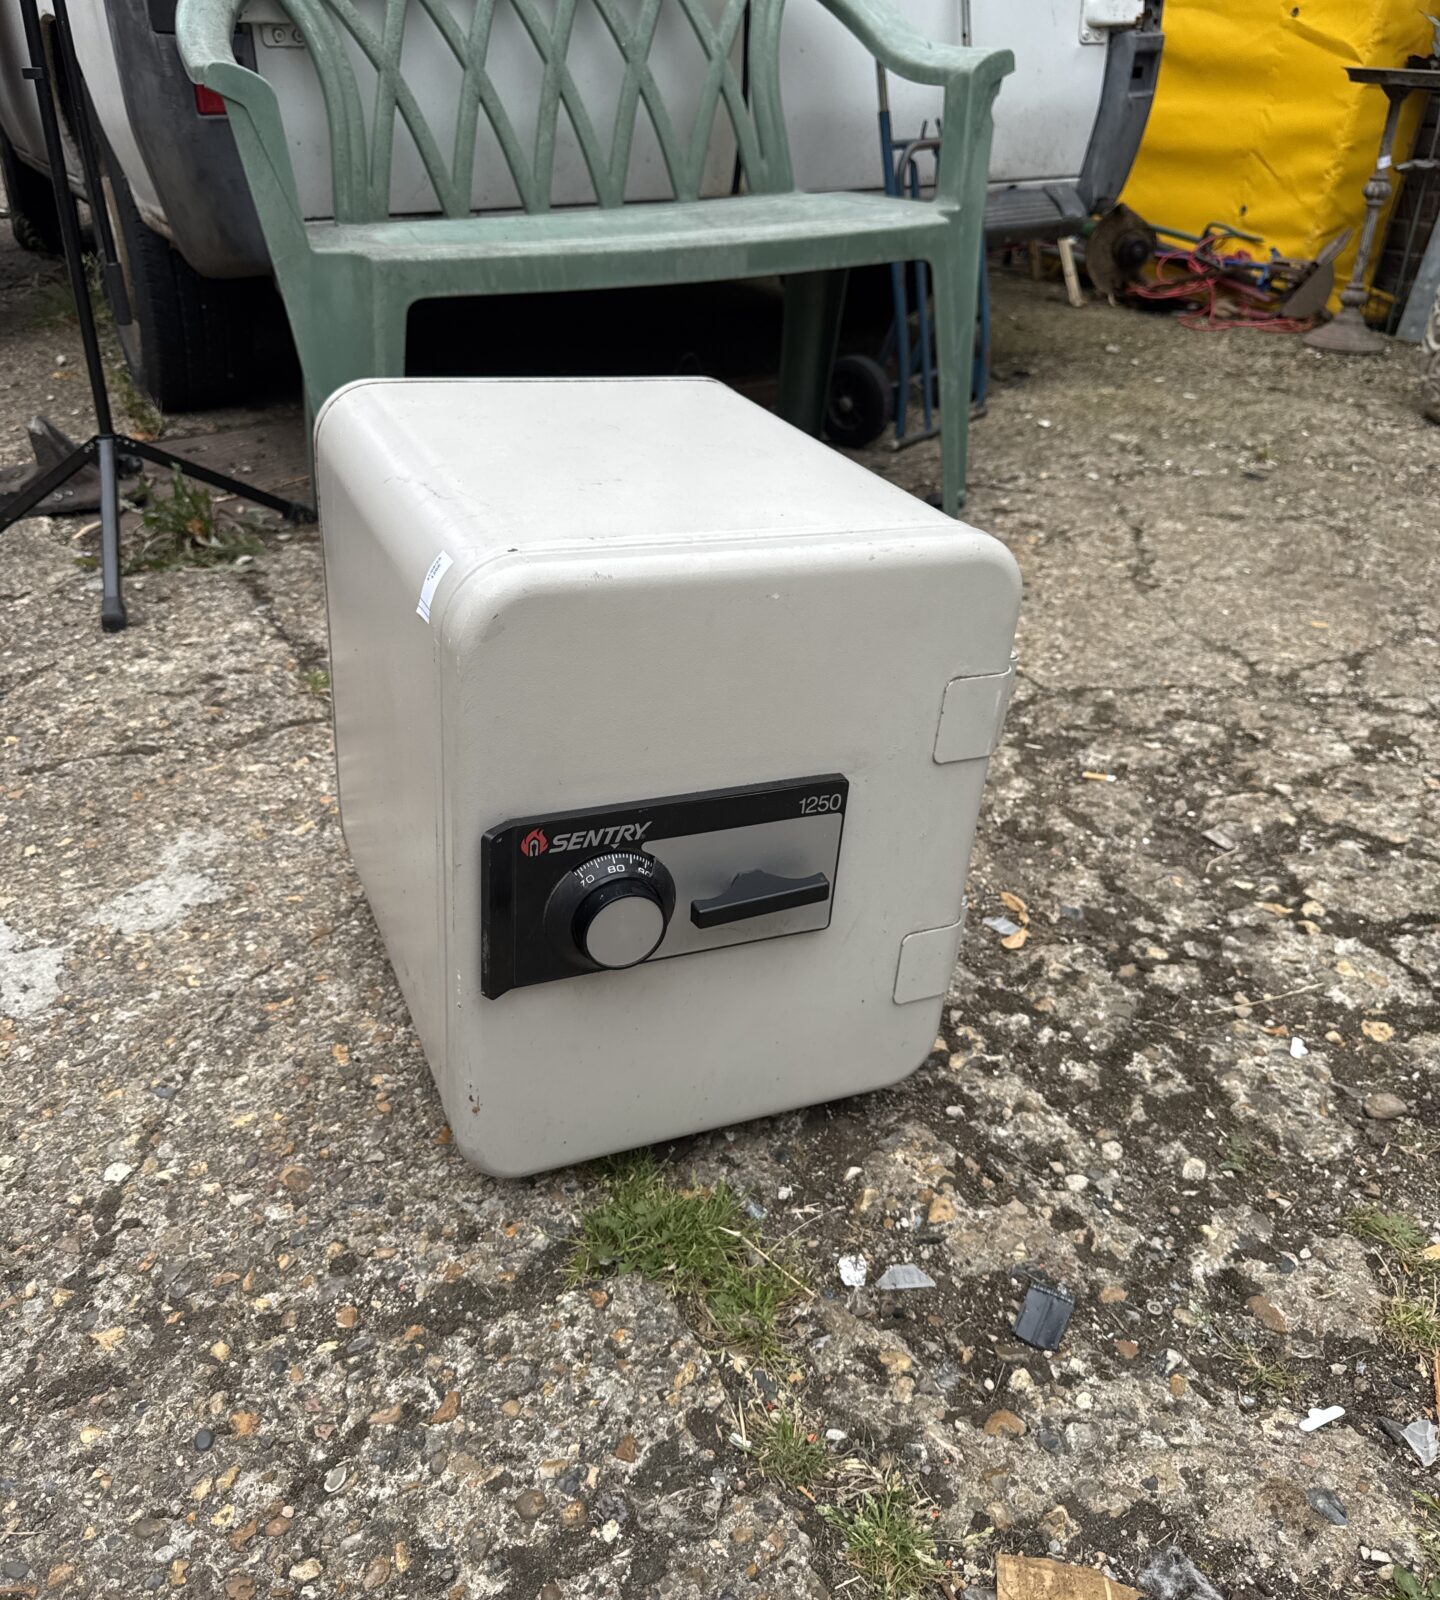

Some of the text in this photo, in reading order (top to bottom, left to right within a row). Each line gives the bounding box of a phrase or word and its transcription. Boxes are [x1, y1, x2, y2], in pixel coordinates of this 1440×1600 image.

[799, 793, 842, 814] 1250
[548, 821, 653, 853] SENTRY
[607, 864, 625, 873] 80
[580, 874, 595, 887] 70
